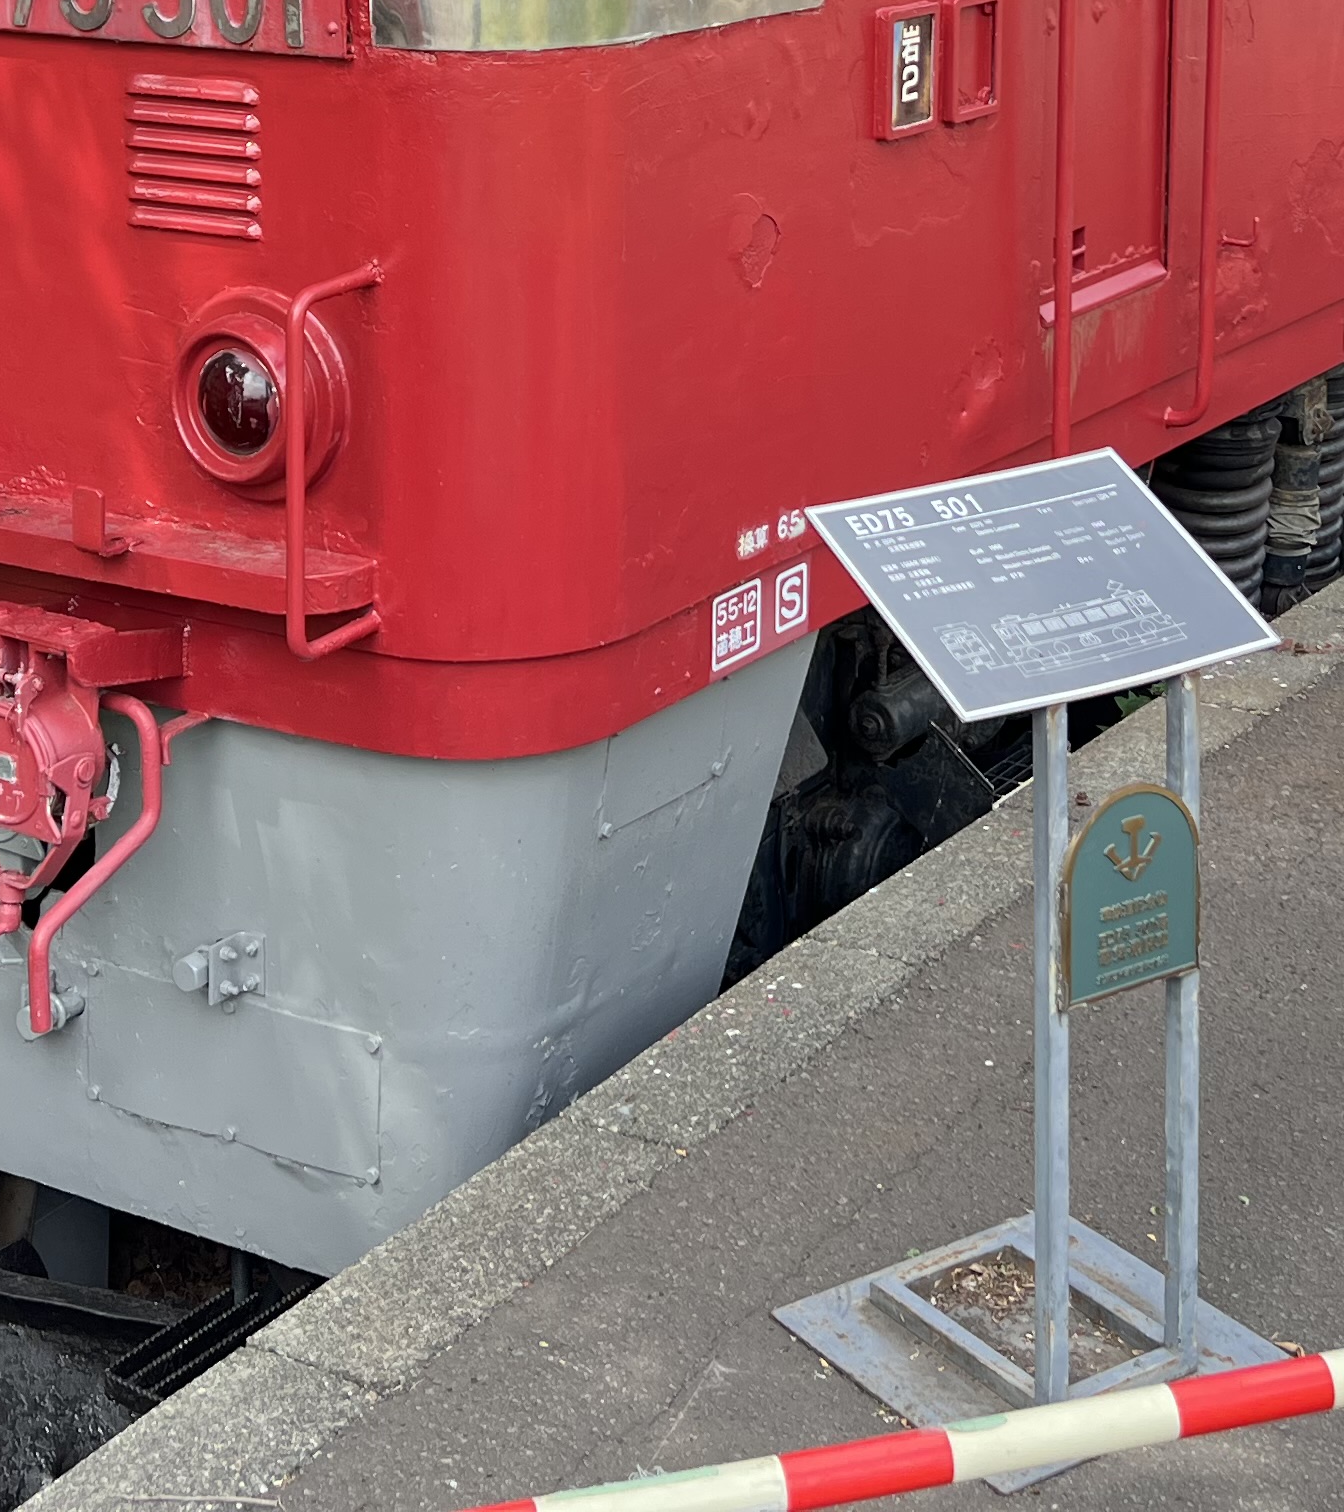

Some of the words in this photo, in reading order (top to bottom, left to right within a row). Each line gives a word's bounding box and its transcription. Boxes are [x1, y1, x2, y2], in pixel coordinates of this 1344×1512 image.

[845, 506, 915, 536] ED75
[930, 493, 983, 520] 501
[780, 576, 801, 619] S
